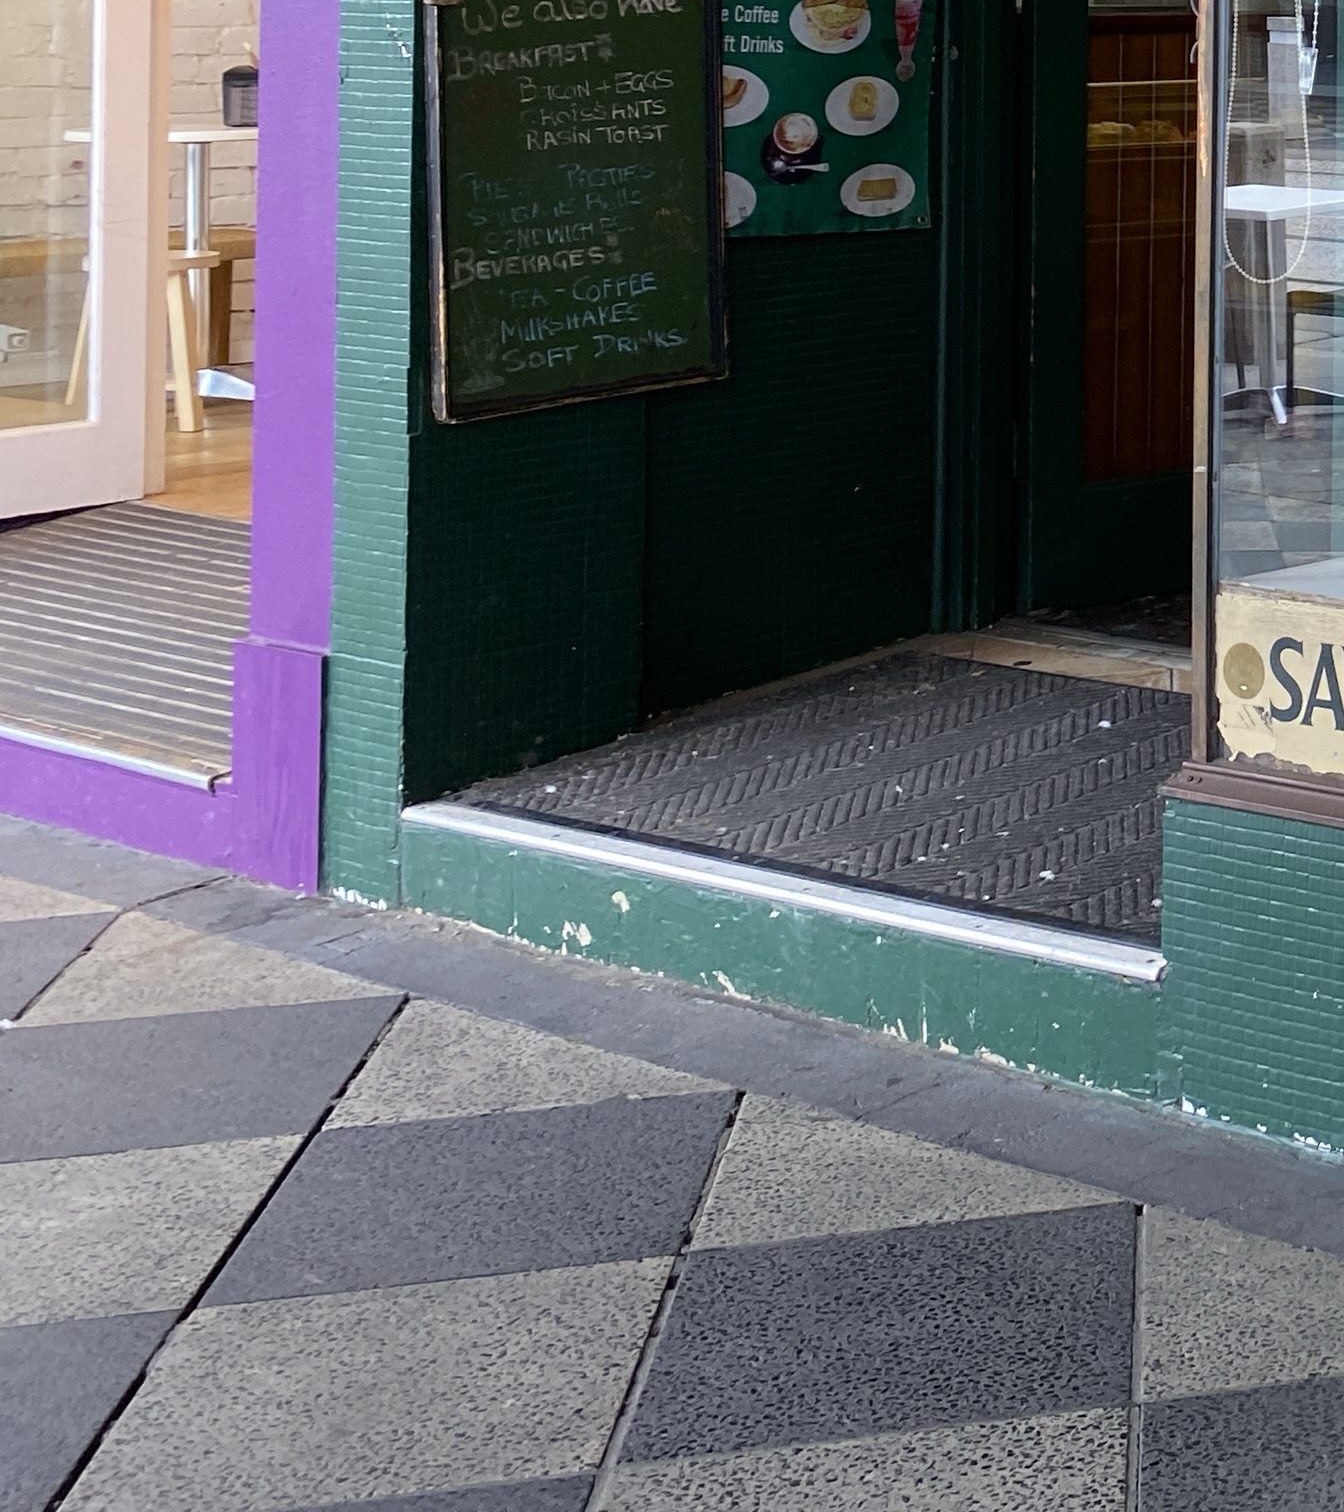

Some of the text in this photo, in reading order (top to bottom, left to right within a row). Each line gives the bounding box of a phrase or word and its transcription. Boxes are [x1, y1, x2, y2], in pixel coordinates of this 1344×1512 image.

[733, 6, 780, 25] Coffee
[740, 36, 784, 55] Drinks
[614, 69, 675, 93] EGGS
[597, 124, 670, 144] TOAST
